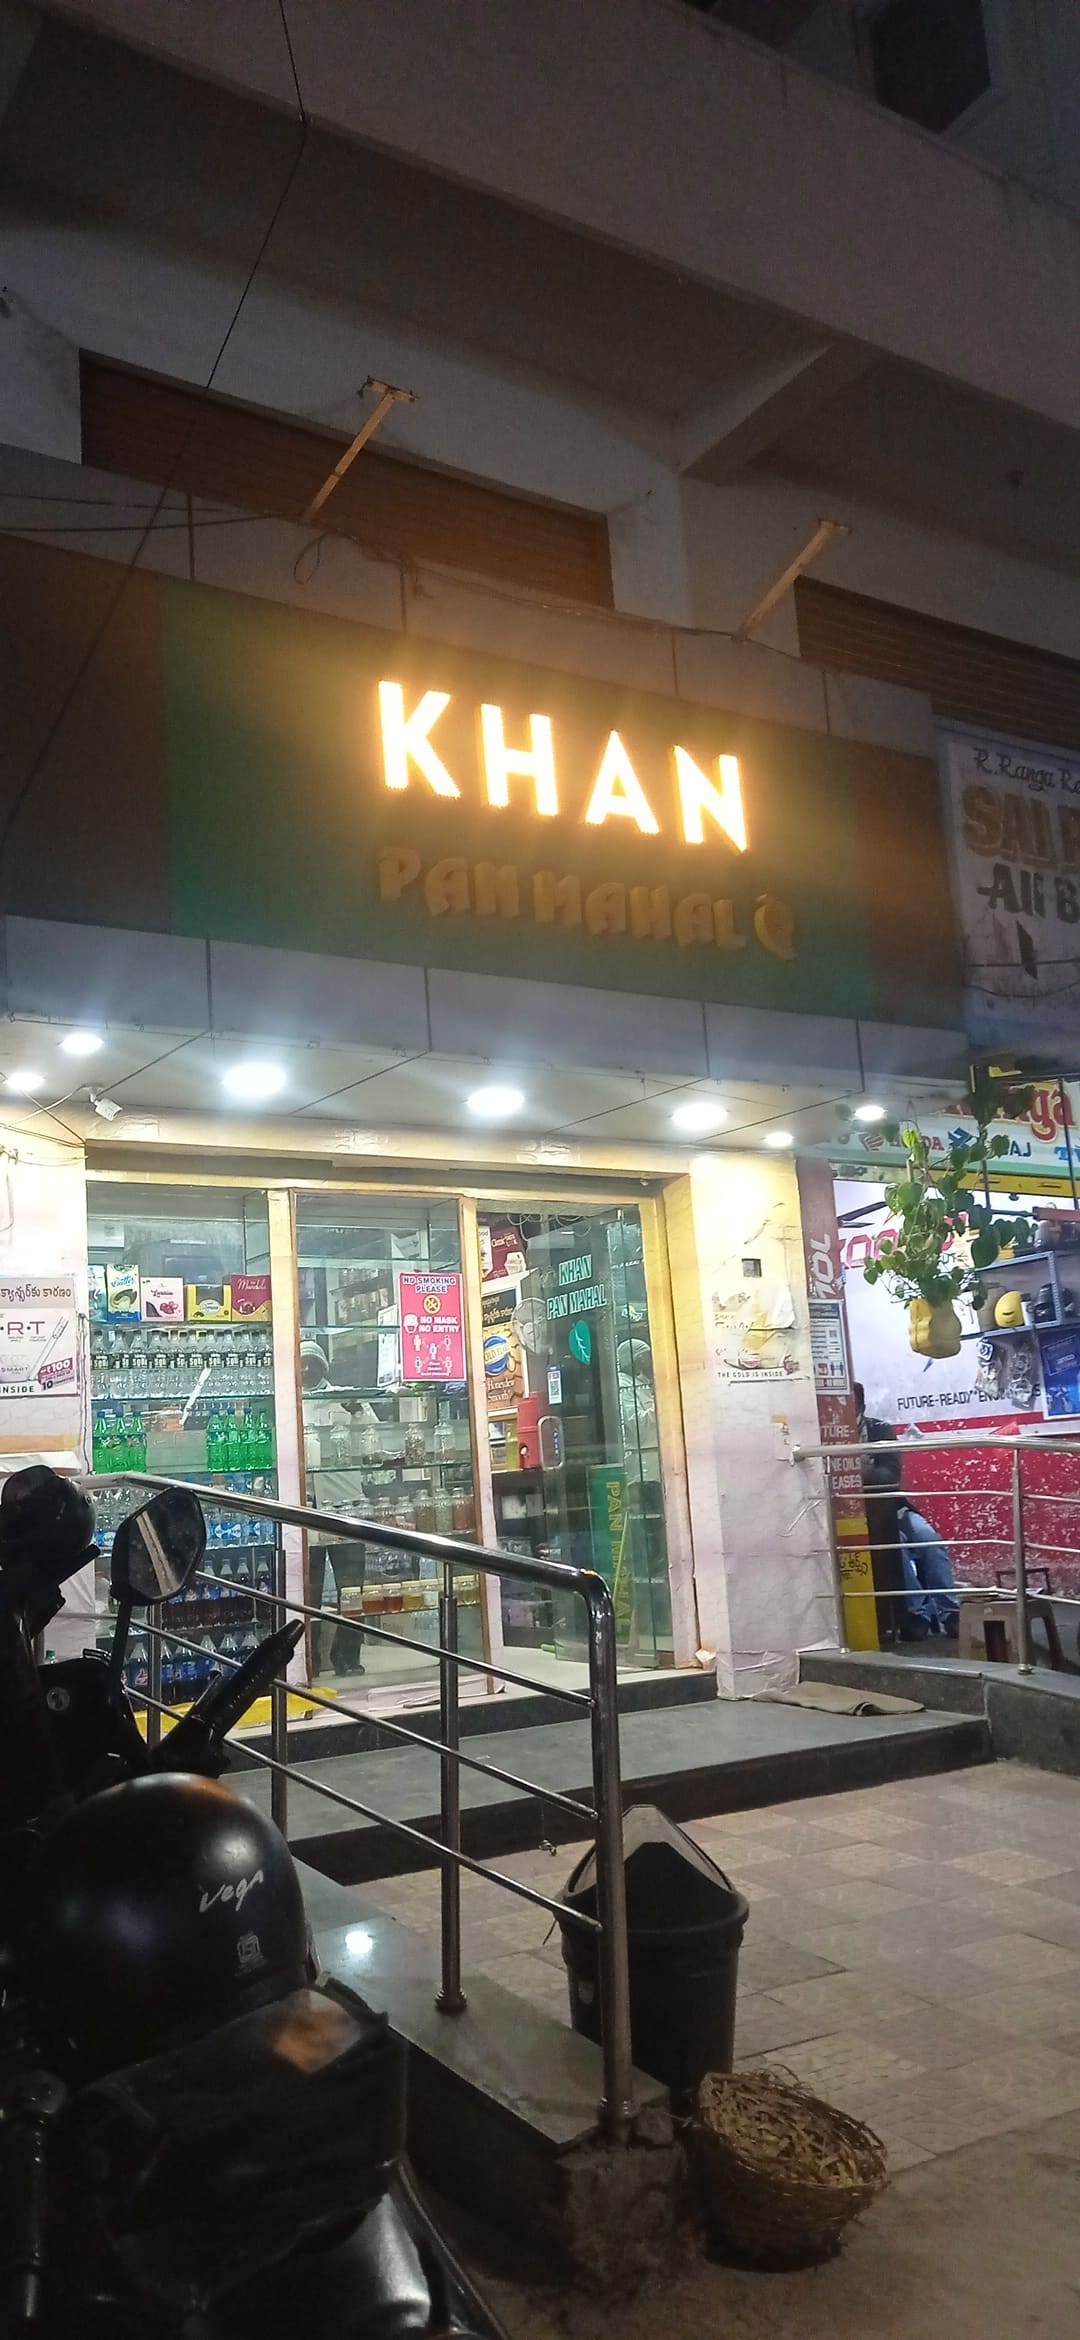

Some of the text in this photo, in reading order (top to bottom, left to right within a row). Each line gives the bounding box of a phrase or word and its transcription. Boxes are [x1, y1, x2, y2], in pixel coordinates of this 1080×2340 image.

[377, 679, 752, 855] KHAN
[377, 846, 748, 952] PAN MAHAL
[558, 1254, 592, 1286] KHAN
[403, 1276, 457, 1287] NO SMOKING
[415, 1284, 448, 1294] PLEASE
[546, 1284, 608, 1321] PAN MAHAL
[420, 1316, 458, 1325] NO MASK
[418, 1324, 461, 1333] NO ENTRY
[732, 1371, 750, 1379] GOLD
[752, 1370, 759, 1378] IS
[761, 1369, 783, 1378] INSIDE
[42, 1380, 54, 1391] 10
[821, 1425, 855, 1439] TURE-
[832, 1475, 863, 1490] EASES
[606, 1481, 624, 1531] PAN
